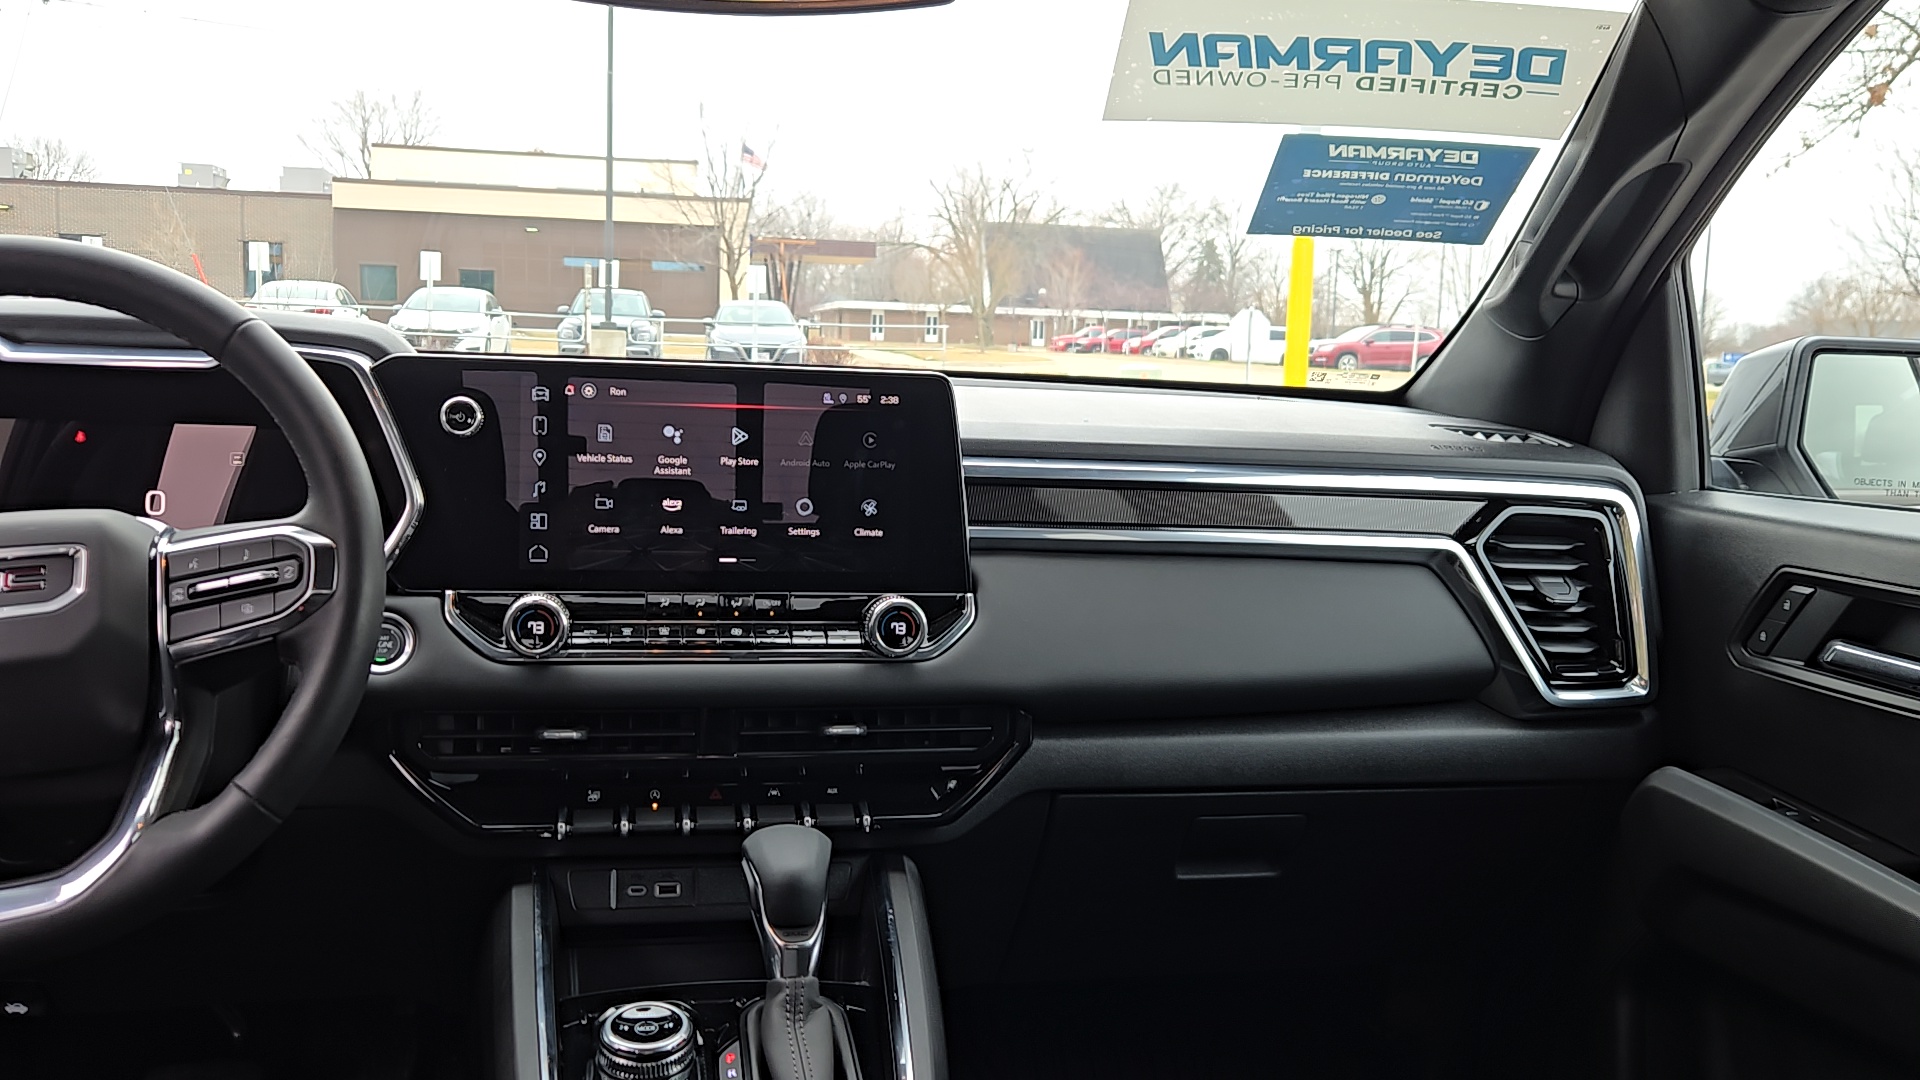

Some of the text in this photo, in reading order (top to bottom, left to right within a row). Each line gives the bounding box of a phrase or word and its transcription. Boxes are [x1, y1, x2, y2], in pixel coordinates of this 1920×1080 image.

[609, 386, 628, 397] Ron
[879, 395, 900, 405] 2:38
[576, 453, 634, 464] Vehicle Status
[657, 455, 688, 466] Google
[719, 456, 760, 468] Play Store
[780, 458, 831, 468] Android Auto
[843, 460, 896, 470] Apple CarPlay
[653, 466, 692, 476] Assistant
[1853, 477, 1894, 488] OBJECTS
[1897, 480, 1907, 488] IN
[1885, 489, 1910, 498] THAN
[144, 489, 167, 516] 0
[587, 523, 621, 534] Camera
[659, 525, 684, 535] Alexa
[719, 525, 758, 538] Trailering
[787, 526, 821, 538] Settings
[853, 527, 884, 538] Climate
[527, 620, 545, 635] 73
[890, 621, 907, 635] 73
[725, 1052, 737, 1064] P
[727, 1068, 738, 1079] R
